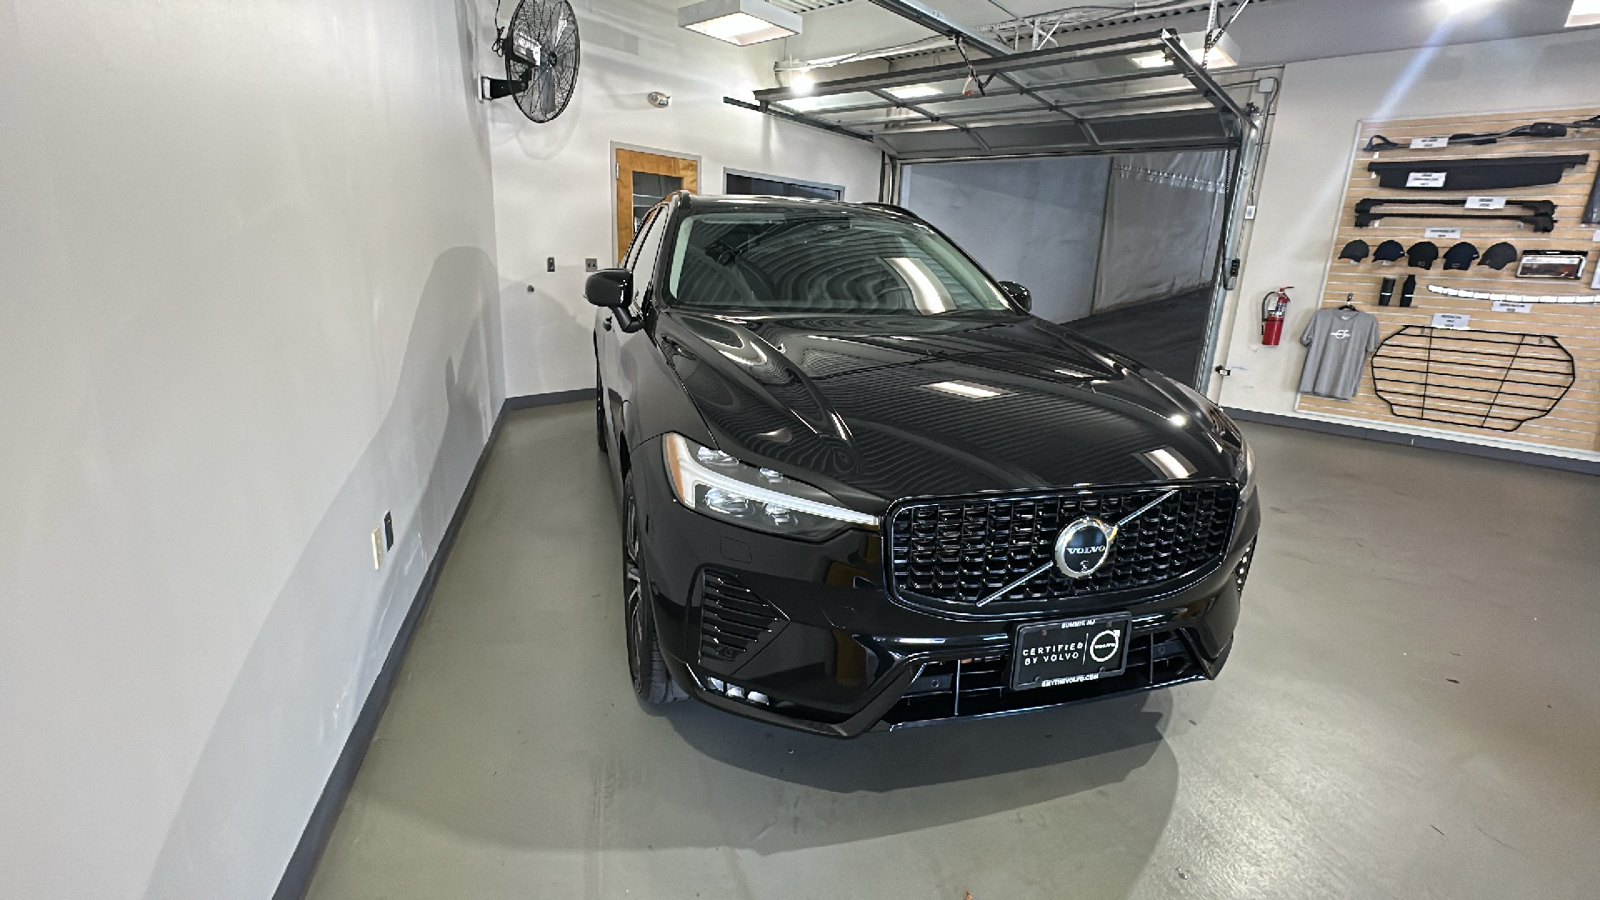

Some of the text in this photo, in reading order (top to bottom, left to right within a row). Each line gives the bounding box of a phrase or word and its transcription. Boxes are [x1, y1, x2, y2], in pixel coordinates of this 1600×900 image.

[1066, 545, 1106, 554] VOLVO
[1022, 642, 1083, 656] CERTIFIED
[1024, 651, 1079, 665] BY VOLVO
